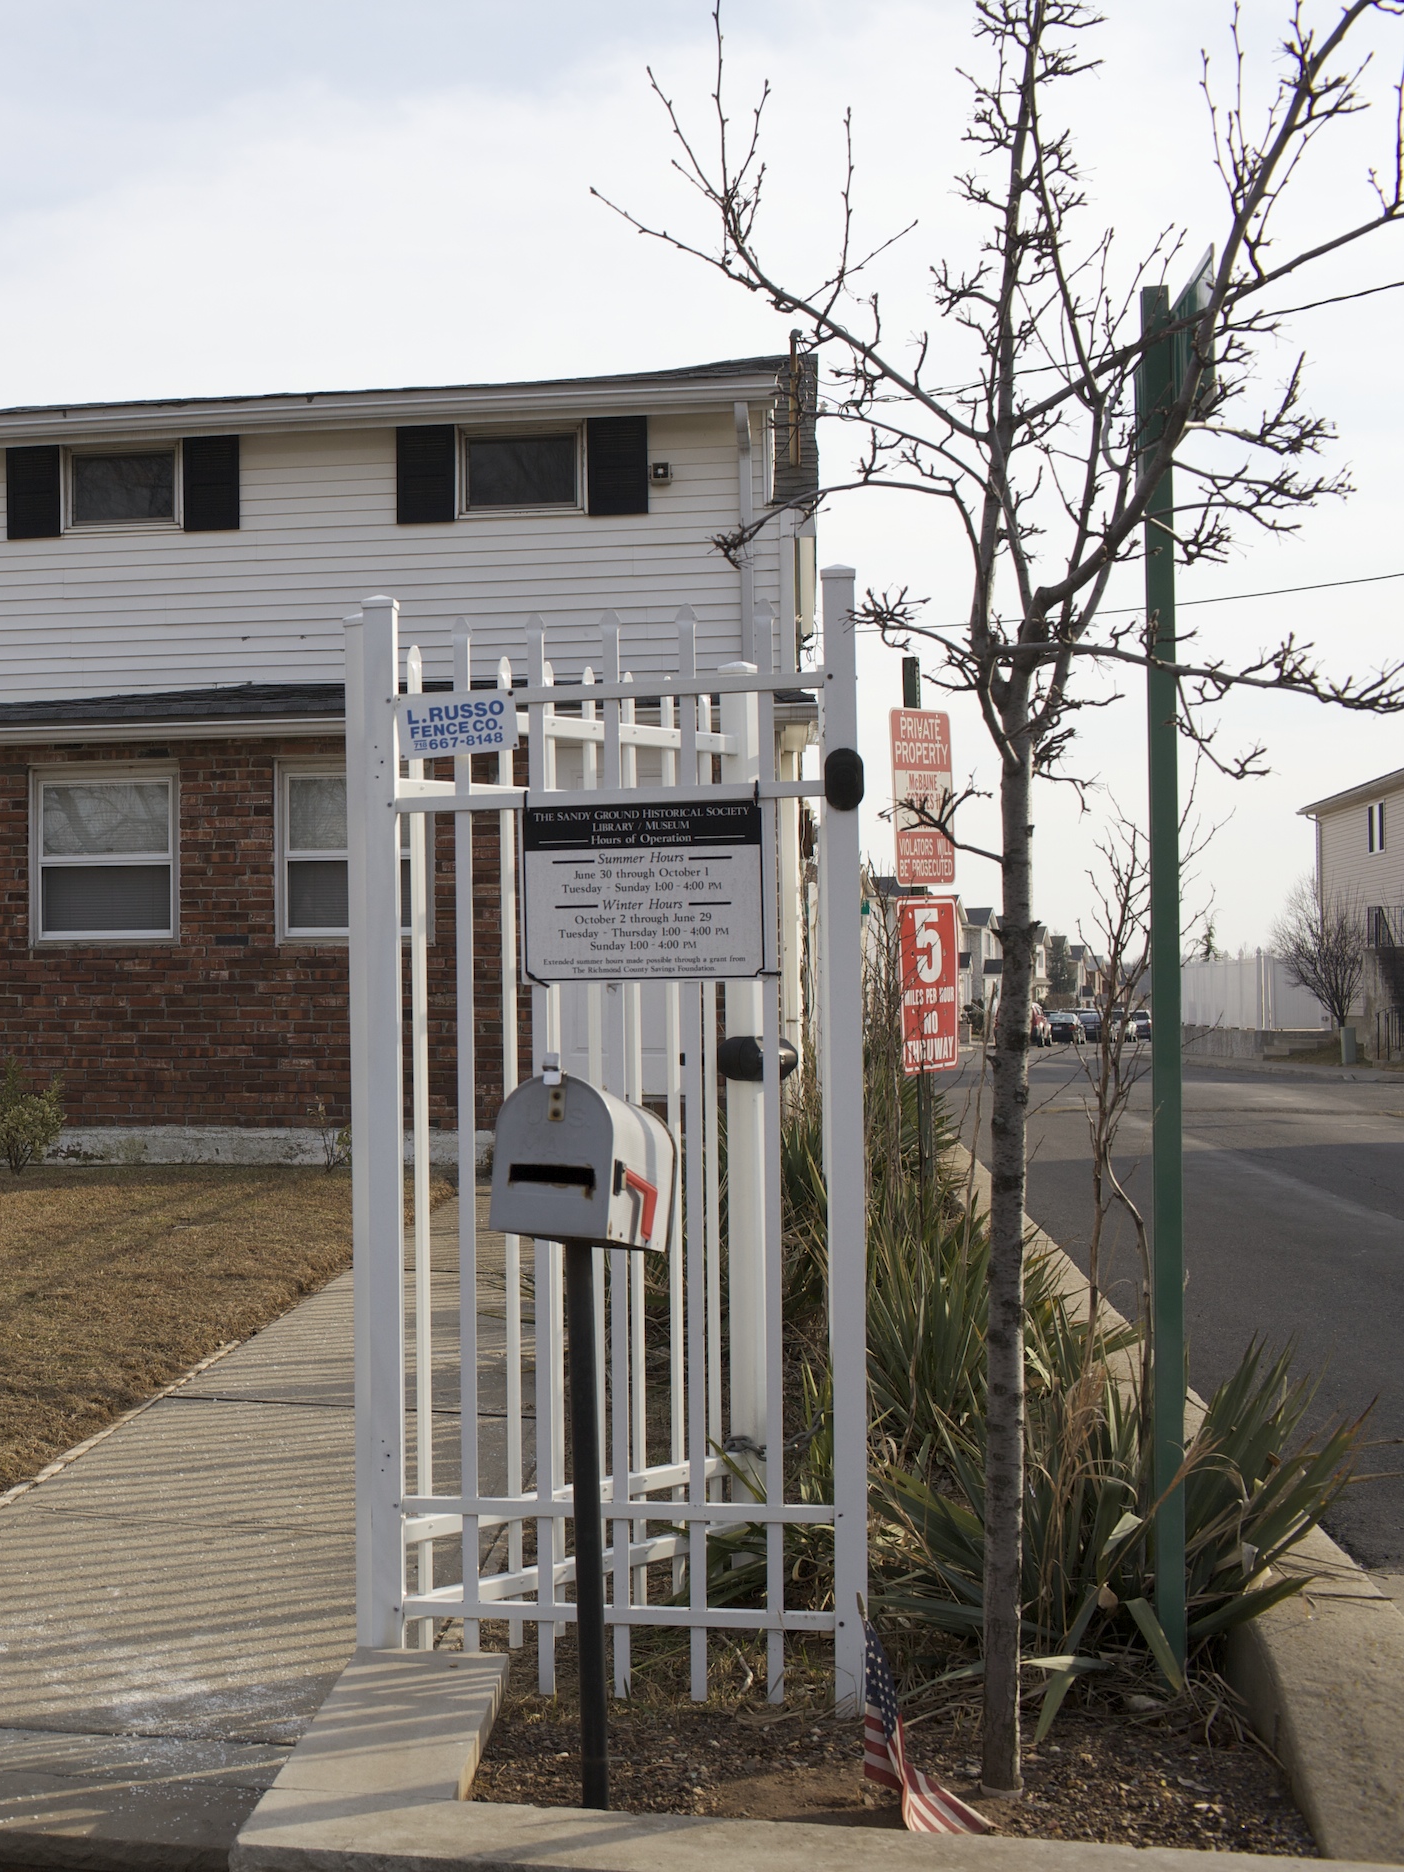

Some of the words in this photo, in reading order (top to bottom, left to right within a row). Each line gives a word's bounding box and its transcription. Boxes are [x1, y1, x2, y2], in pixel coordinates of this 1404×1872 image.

[410, 721, 469, 739] FENCE
[473, 718, 503, 732] CO.
[900, 716, 942, 740] PRIVATE
[414, 740, 428, 750] 718
[429, 732, 504, 750] 667-8148
[895, 741, 948, 765] PROPERTY
[908, 774, 938, 790] McBAINE
[533, 812, 554, 822] THE
[557, 811, 592, 822] SANDY
[594, 810, 640, 820] GROUND
[642, 808, 704, 818] HISTORICAL
[706, 806, 750, 816] SOCIETY
[592, 822, 634, 832] LIBRARY
[645, 820, 690, 830] MUSEUM
[591, 834, 622, 845] Hours
[625, 833, 637, 844] of
[640, 833, 692, 845] Operation
[899, 838, 933, 856] VIOLATORS
[936, 838, 952, 856] WILL
[598, 853, 644, 864] Summer
[650, 851, 684, 863] Hours
[574, 870, 596, 880] June
[600, 869, 612, 879] 30
[616, 868, 654, 880] through
[659, 867, 701, 877] October
[900, 858, 908, 877] BE
[912, 859, 952, 876] PROSECUTED
[562, 883, 602, 894] Tuesday
[614, 882, 651, 894] Sunday
[654, 882, 674, 891] 1:00
[683, 881, 704, 891] 4:00
[708, 882, 722, 890] PM
[603, 899, 644, 911] Winter
[649, 898, 683, 910] Hours
[574, 914, 616, 924] October
[620, 914, 626, 924] 2
[630, 913, 669, 924] through
[672, 912, 695, 923] June
[699, 912, 712, 922] 29
[558, 928, 599, 940] Tuesday
[611, 927, 658, 938] Thursday
[662, 927, 680, 936] 1:00
[690, 926, 711, 936] 4:00
[590, 941, 626, 952] Sunday
[630, 940, 649, 950] 1:00
[658, 940, 679, 949] 4:00
[683, 941, 697, 949] PM
[914, 908, 942, 984] 5
[674, 956, 700, 964] through
[572, 966, 585, 974] The
[623, 966, 648, 974] County
[904, 989, 924, 1006] MILES
[926, 988, 937, 1004] PER
[939, 986, 954, 1003] HOUR
[924, 1010, 938, 1034] NO
